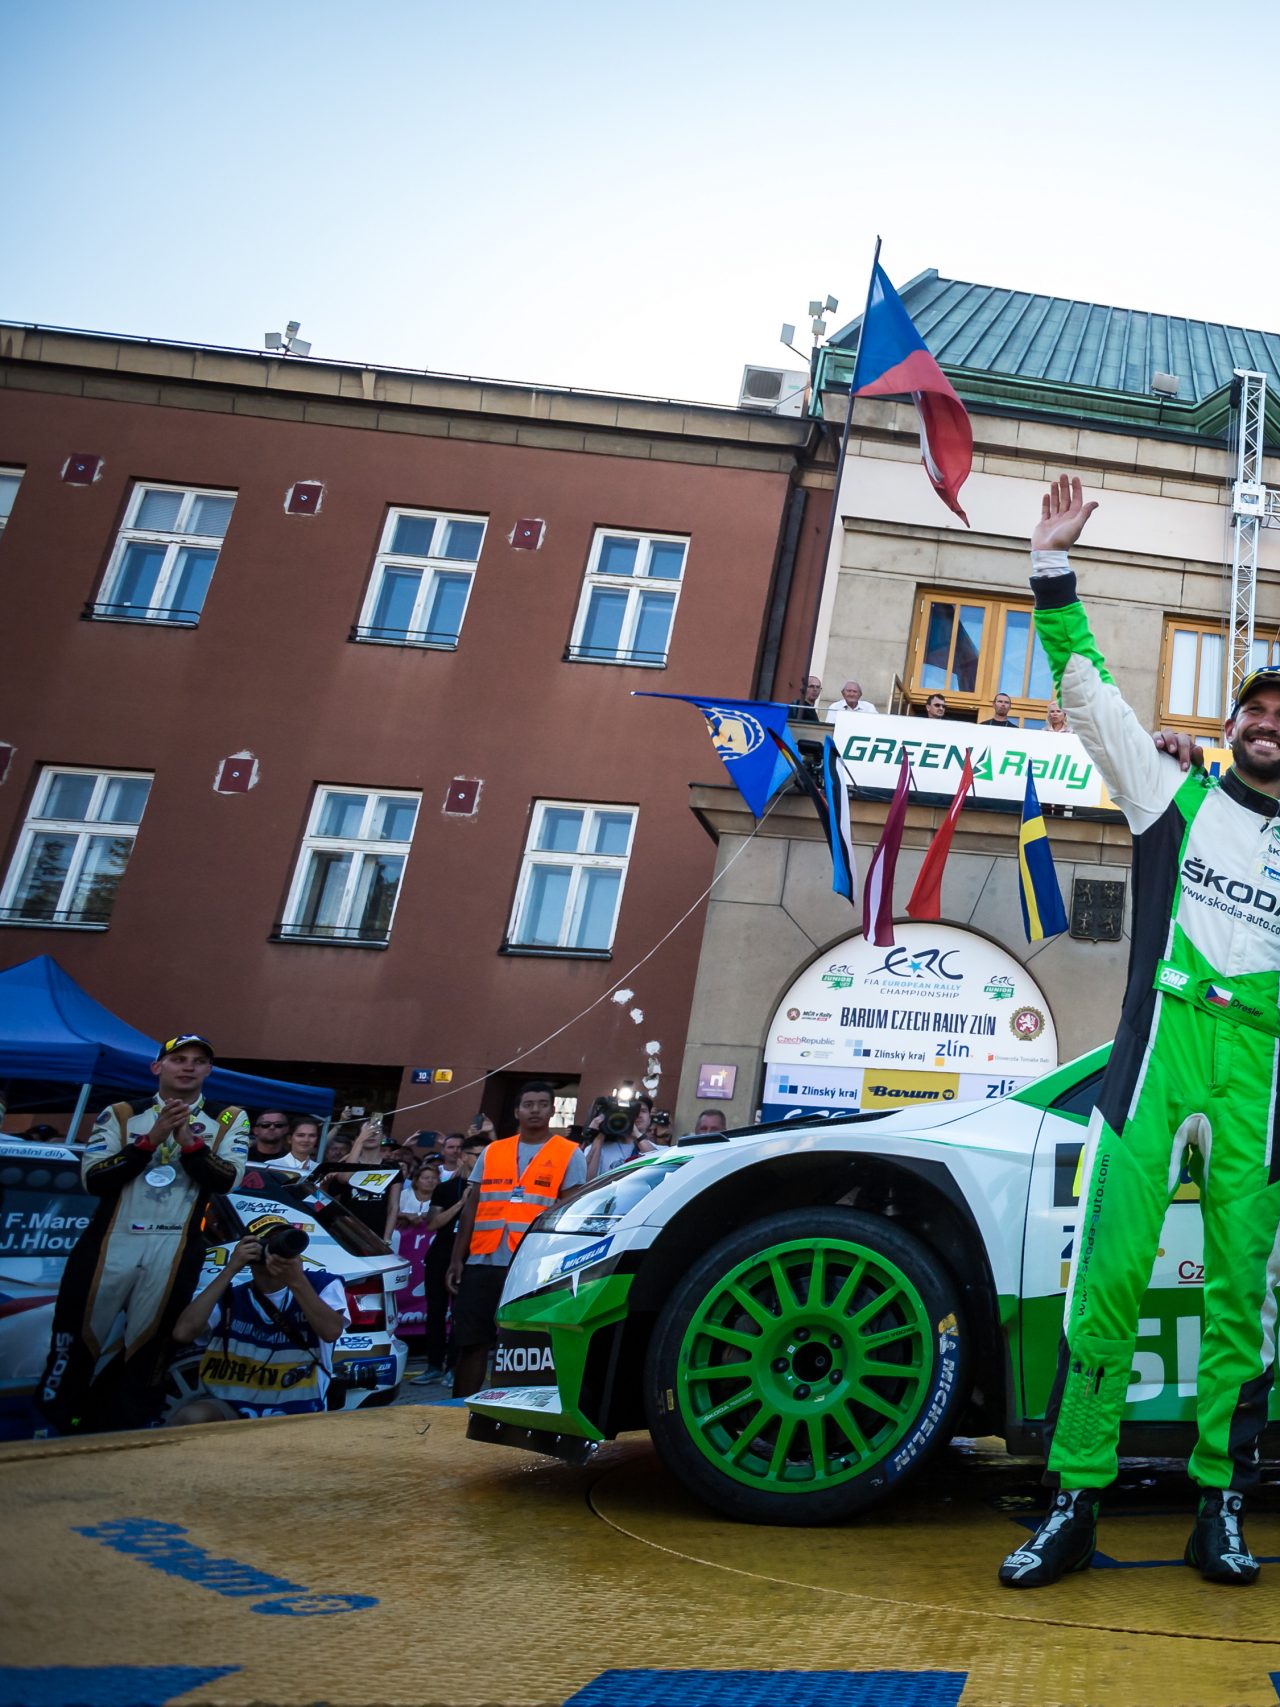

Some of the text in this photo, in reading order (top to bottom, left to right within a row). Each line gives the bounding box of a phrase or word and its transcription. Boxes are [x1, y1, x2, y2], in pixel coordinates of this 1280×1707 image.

[842, 735, 1093, 790] GREEN Rally
[863, 978, 963, 992] FIA EUROPEAN RALLY
[1160, 970, 1188, 987] OMP
[880, 987, 960, 999] CHAMPIONSHIP
[1231, 998, 1264, 1018] Dresler
[840, 1007, 997, 1036] BARUM CZECH RALLY ZLÍN
[874, 1049, 926, 1062] Zlínský kraj
[936, 1040, 970, 1057] zlín
[801, 1085, 858, 1100] Zlínský kraj
[871, 1085, 940, 1100] Barum
[986, 1080, 1018, 1099] zlí
[5, 1213, 93, 1229] F.Mare
[0, 1232, 79, 1250] J.Hlou
[564, 1244, 607, 1270] MICHELIN
[44, 1332, 74, 1401] ŠKODA
[496, 1344, 556, 1372] ŠKODA
[895, 1358, 957, 1473] MICHELIN
